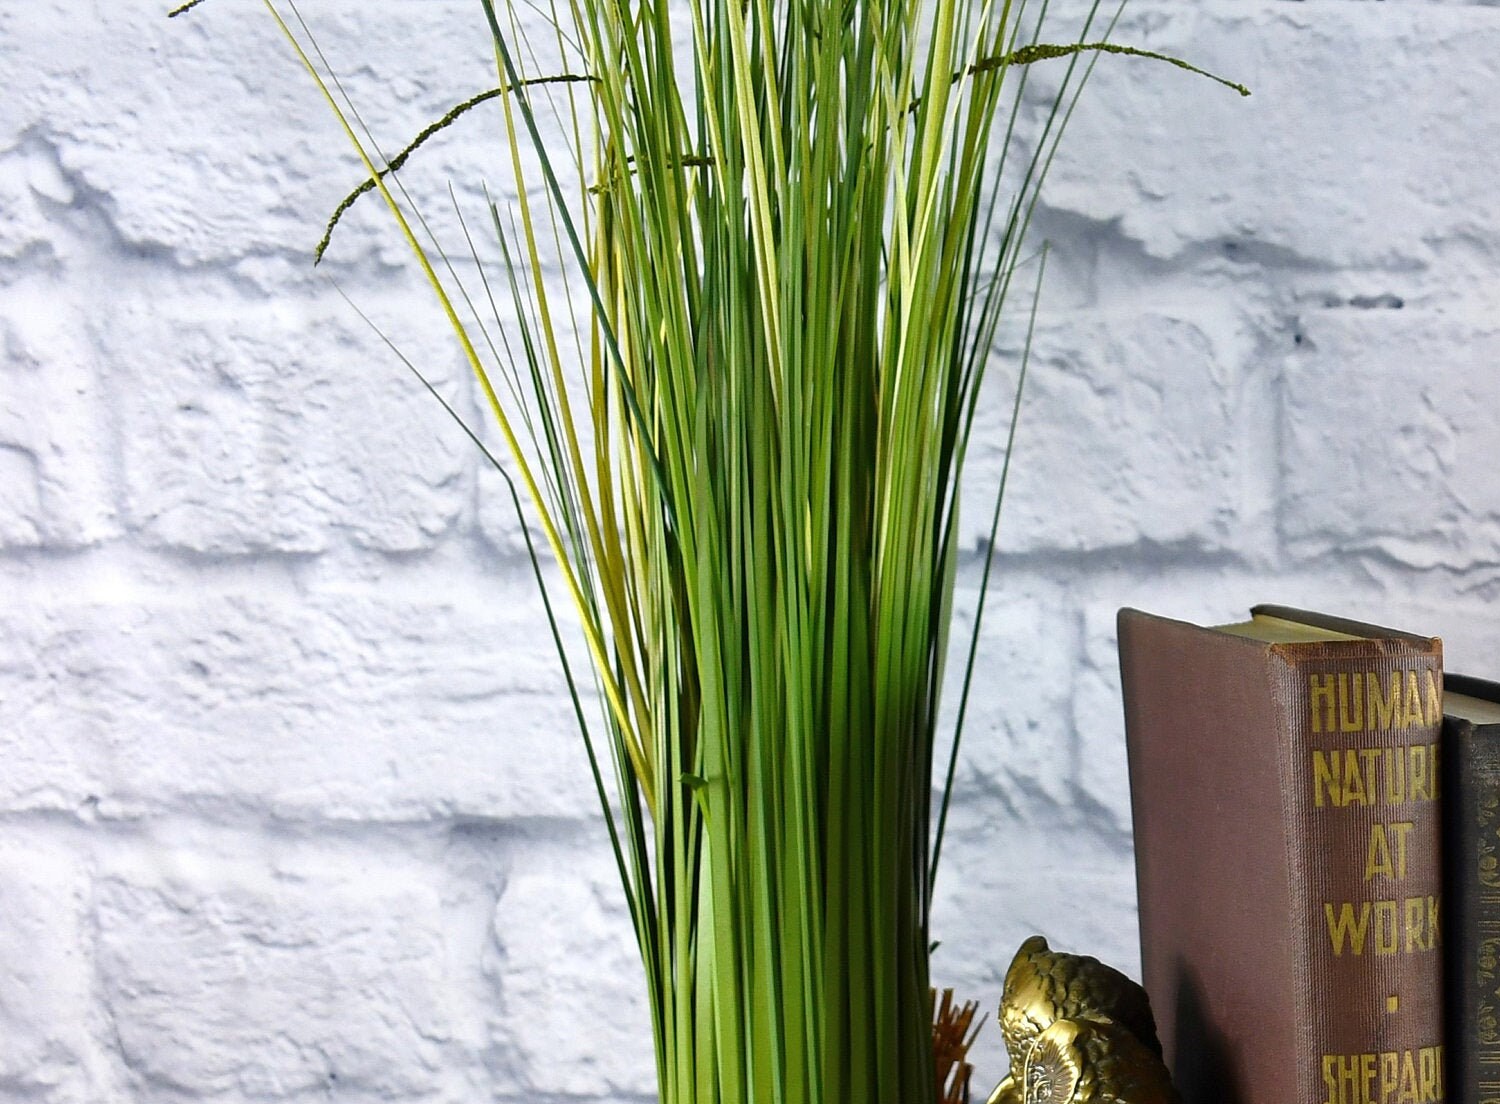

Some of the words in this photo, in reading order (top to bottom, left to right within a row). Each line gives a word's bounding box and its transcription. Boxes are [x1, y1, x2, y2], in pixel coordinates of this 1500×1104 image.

[1310, 669, 1443, 733] HUMAN
[1364, 823, 1414, 881] AT
[1325, 897, 1443, 958] WORK
